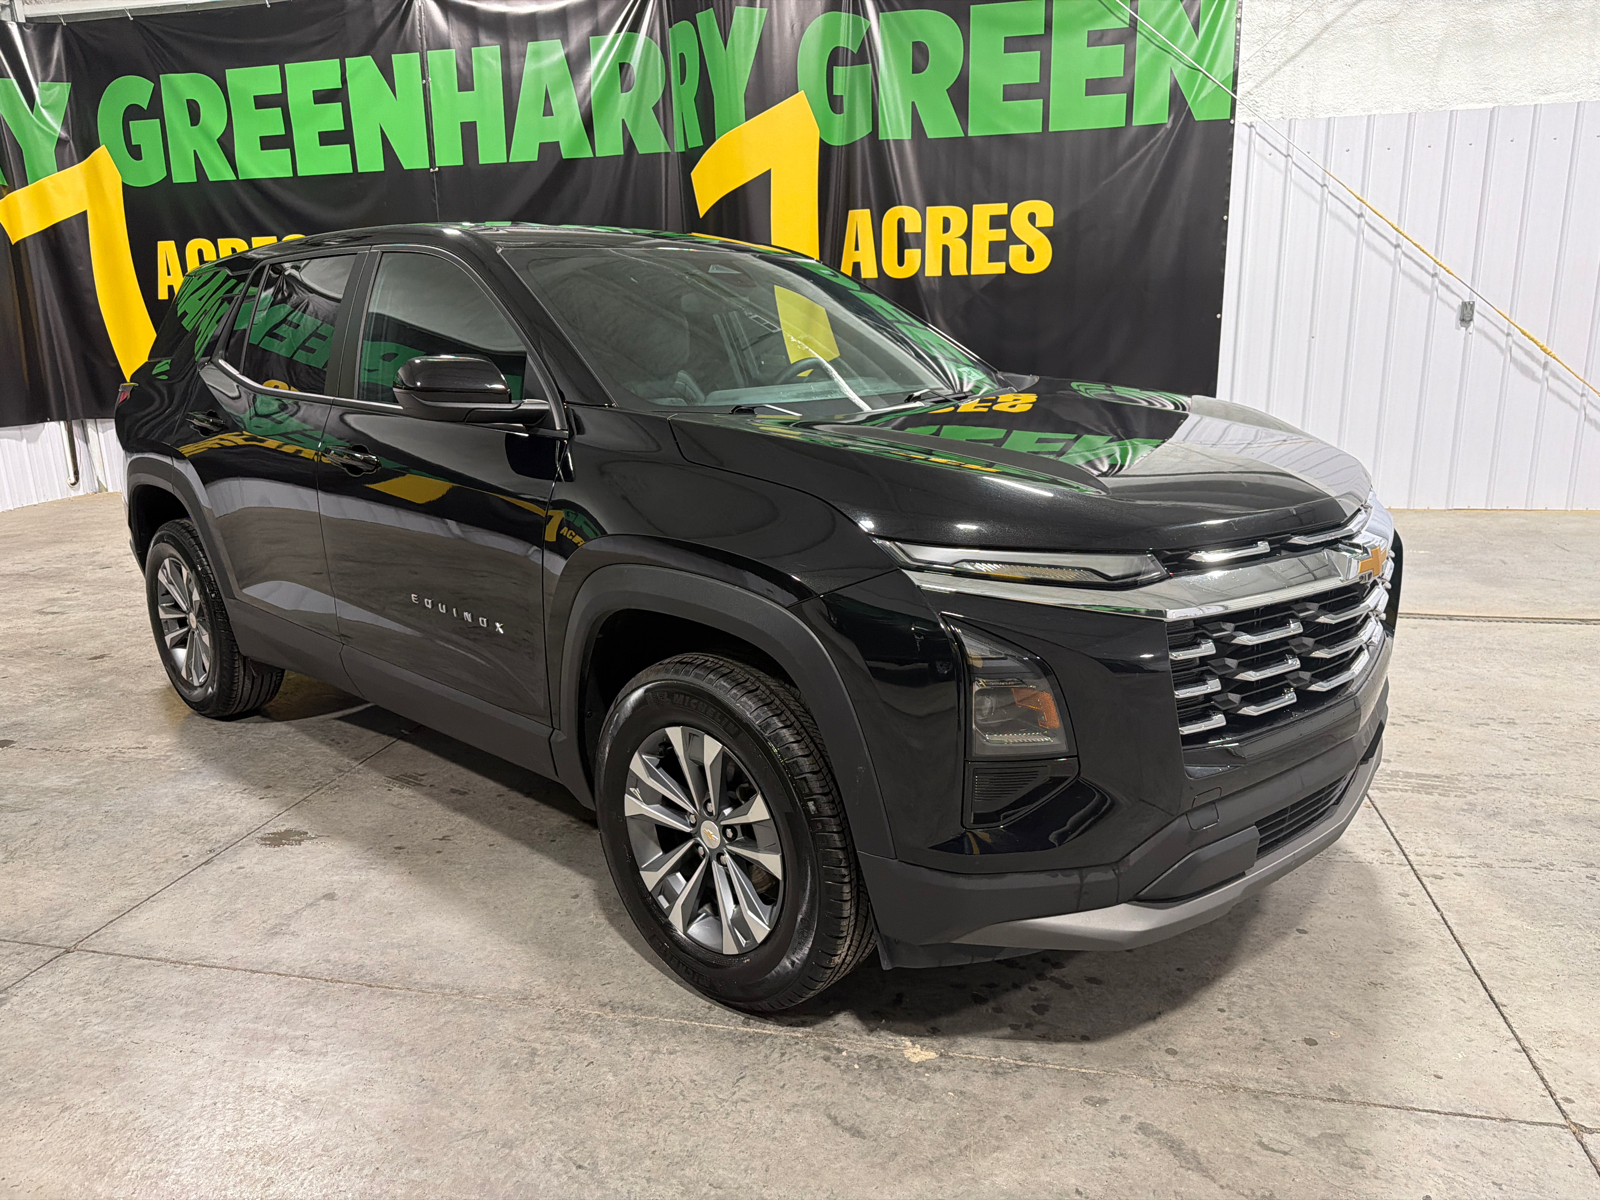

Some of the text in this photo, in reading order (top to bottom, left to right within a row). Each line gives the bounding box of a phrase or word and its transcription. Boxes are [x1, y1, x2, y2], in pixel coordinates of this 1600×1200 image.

[97, 53, 431, 188] GREEN
[427, 0, 1237, 169] HARRY GREEN
[0, 145, 157, 383] 7
[691, 91, 1055, 280] 7 ACRES
[411, 593, 504, 634] EQUINOX
